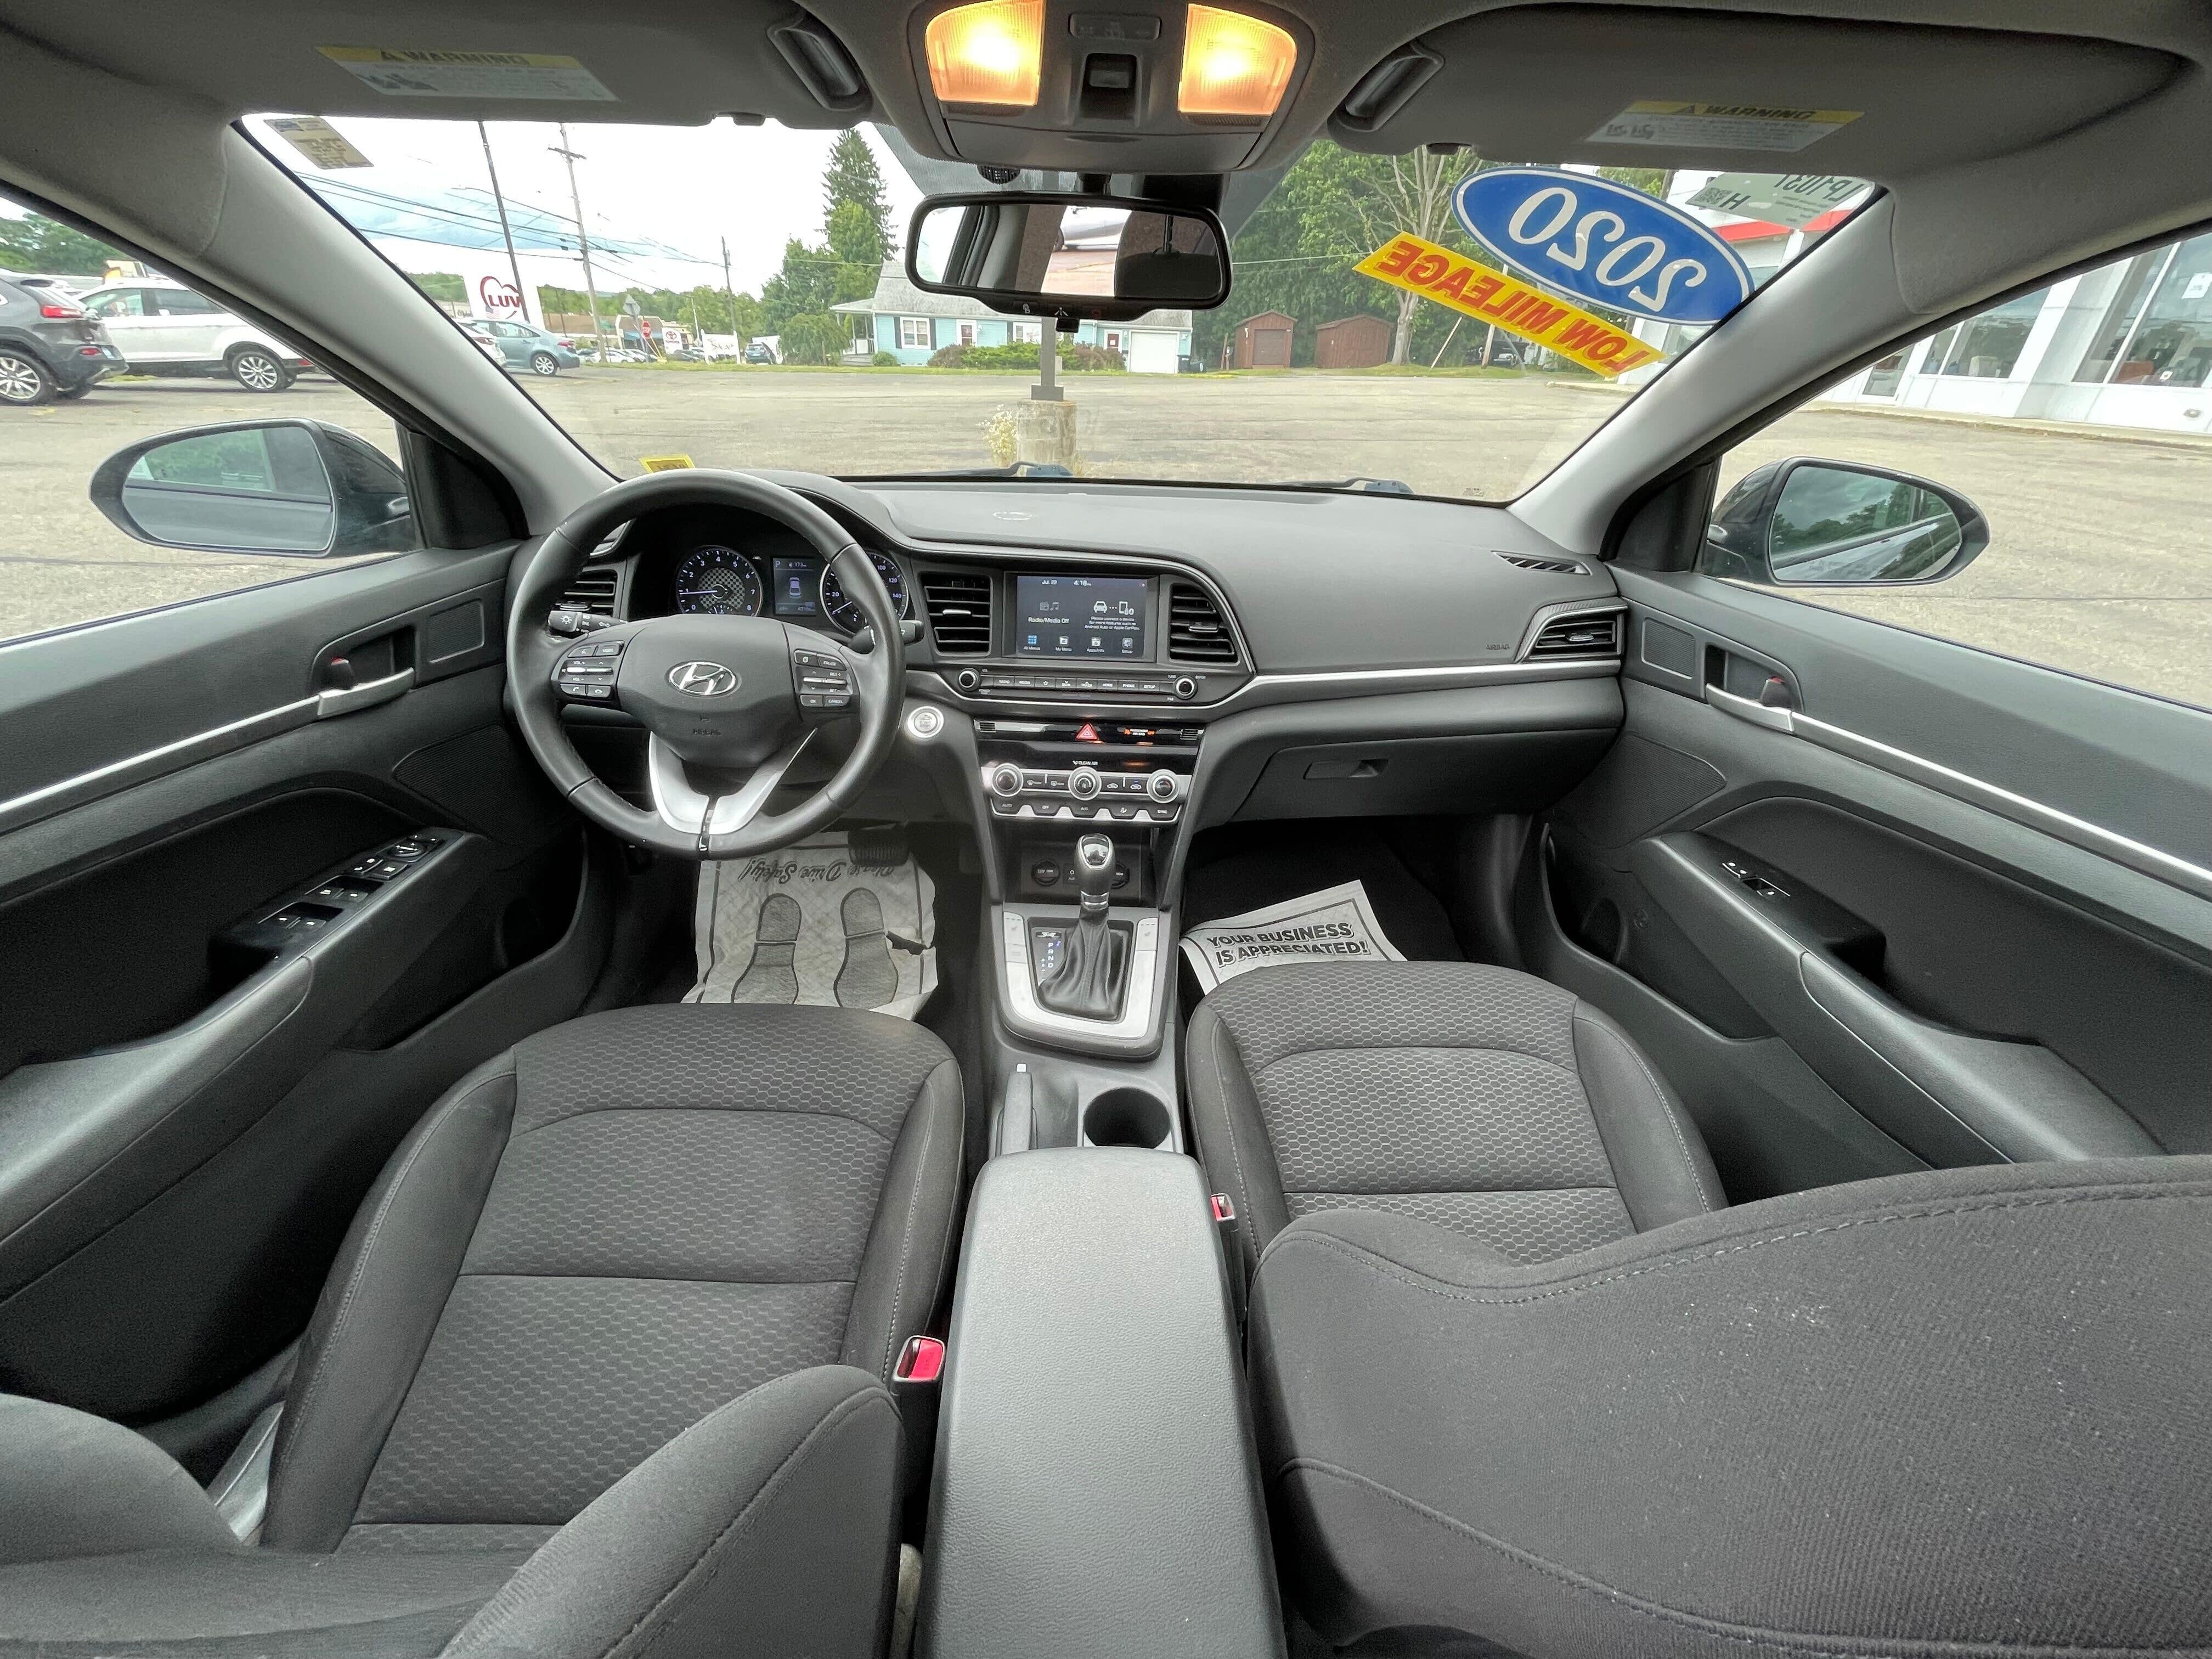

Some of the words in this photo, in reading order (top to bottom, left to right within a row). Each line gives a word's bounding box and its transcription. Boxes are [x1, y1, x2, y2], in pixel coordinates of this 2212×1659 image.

[1703, 105, 1816, 121] WARNING
[738, 858, 797, 884] Safely!
[800, 861, 847, 882] Drive
[1207, 934, 1257, 948] YOUR
[1260, 922, 1353, 944] BUSINESS
[1216, 950, 1235, 966] IS
[1238, 940, 1369, 960] APPRECIATED!
